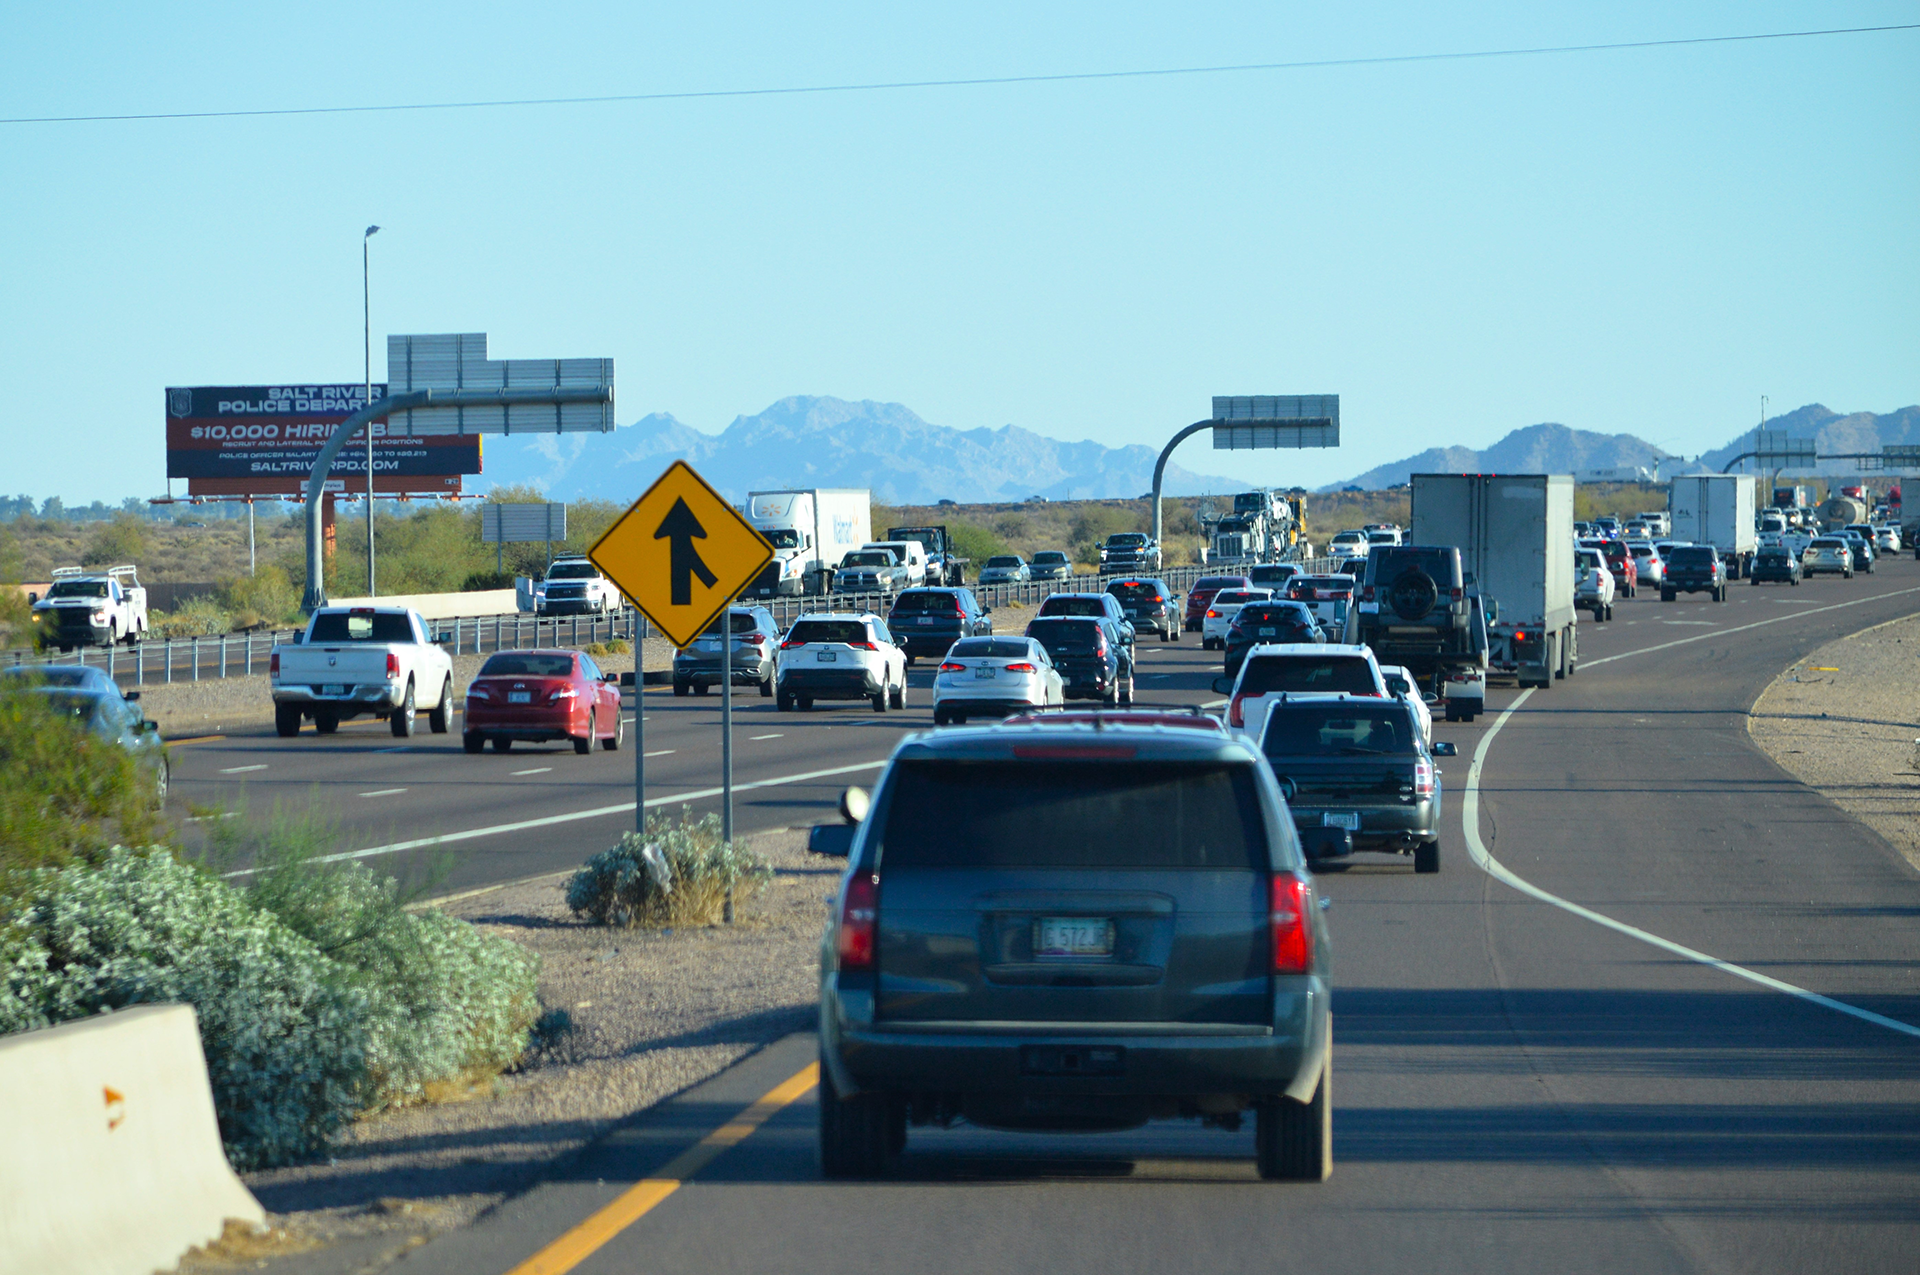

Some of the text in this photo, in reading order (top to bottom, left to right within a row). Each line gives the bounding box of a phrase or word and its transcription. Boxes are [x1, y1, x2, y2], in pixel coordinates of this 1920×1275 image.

[268, 386, 382, 400] SALT RIVER
[218, 398, 291, 413] POLICE
[190, 424, 279, 440] $10,000
[222, 440, 256, 448] RECRUIT
[250, 451, 284, 459] OFFICER
[251, 460, 399, 472] SALTRIVRPD.COM
